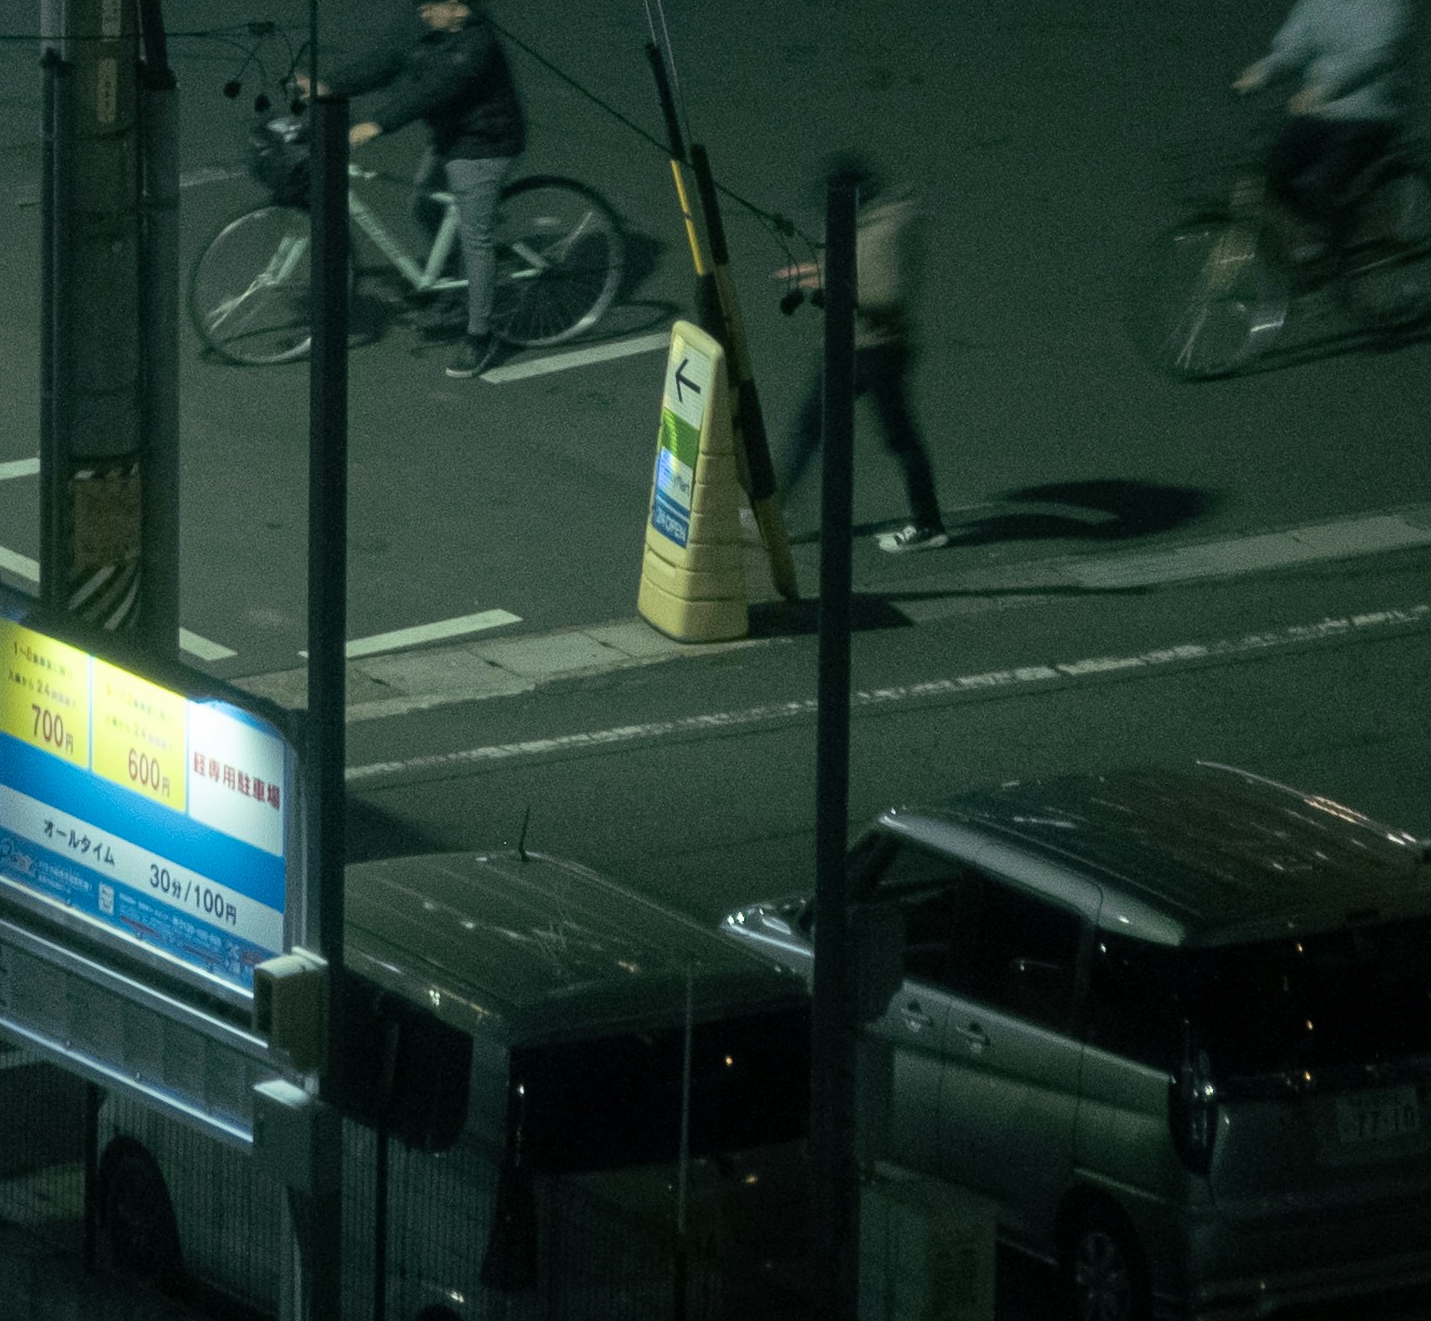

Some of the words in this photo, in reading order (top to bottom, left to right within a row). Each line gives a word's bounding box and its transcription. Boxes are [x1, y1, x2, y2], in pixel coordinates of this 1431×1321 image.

[30, 702, 75, 755] 700円
[127, 747, 171, 798] 600円
[193, 751, 281, 812] 軽専用駐車場
[42, 817, 116, 868] オールタイム
